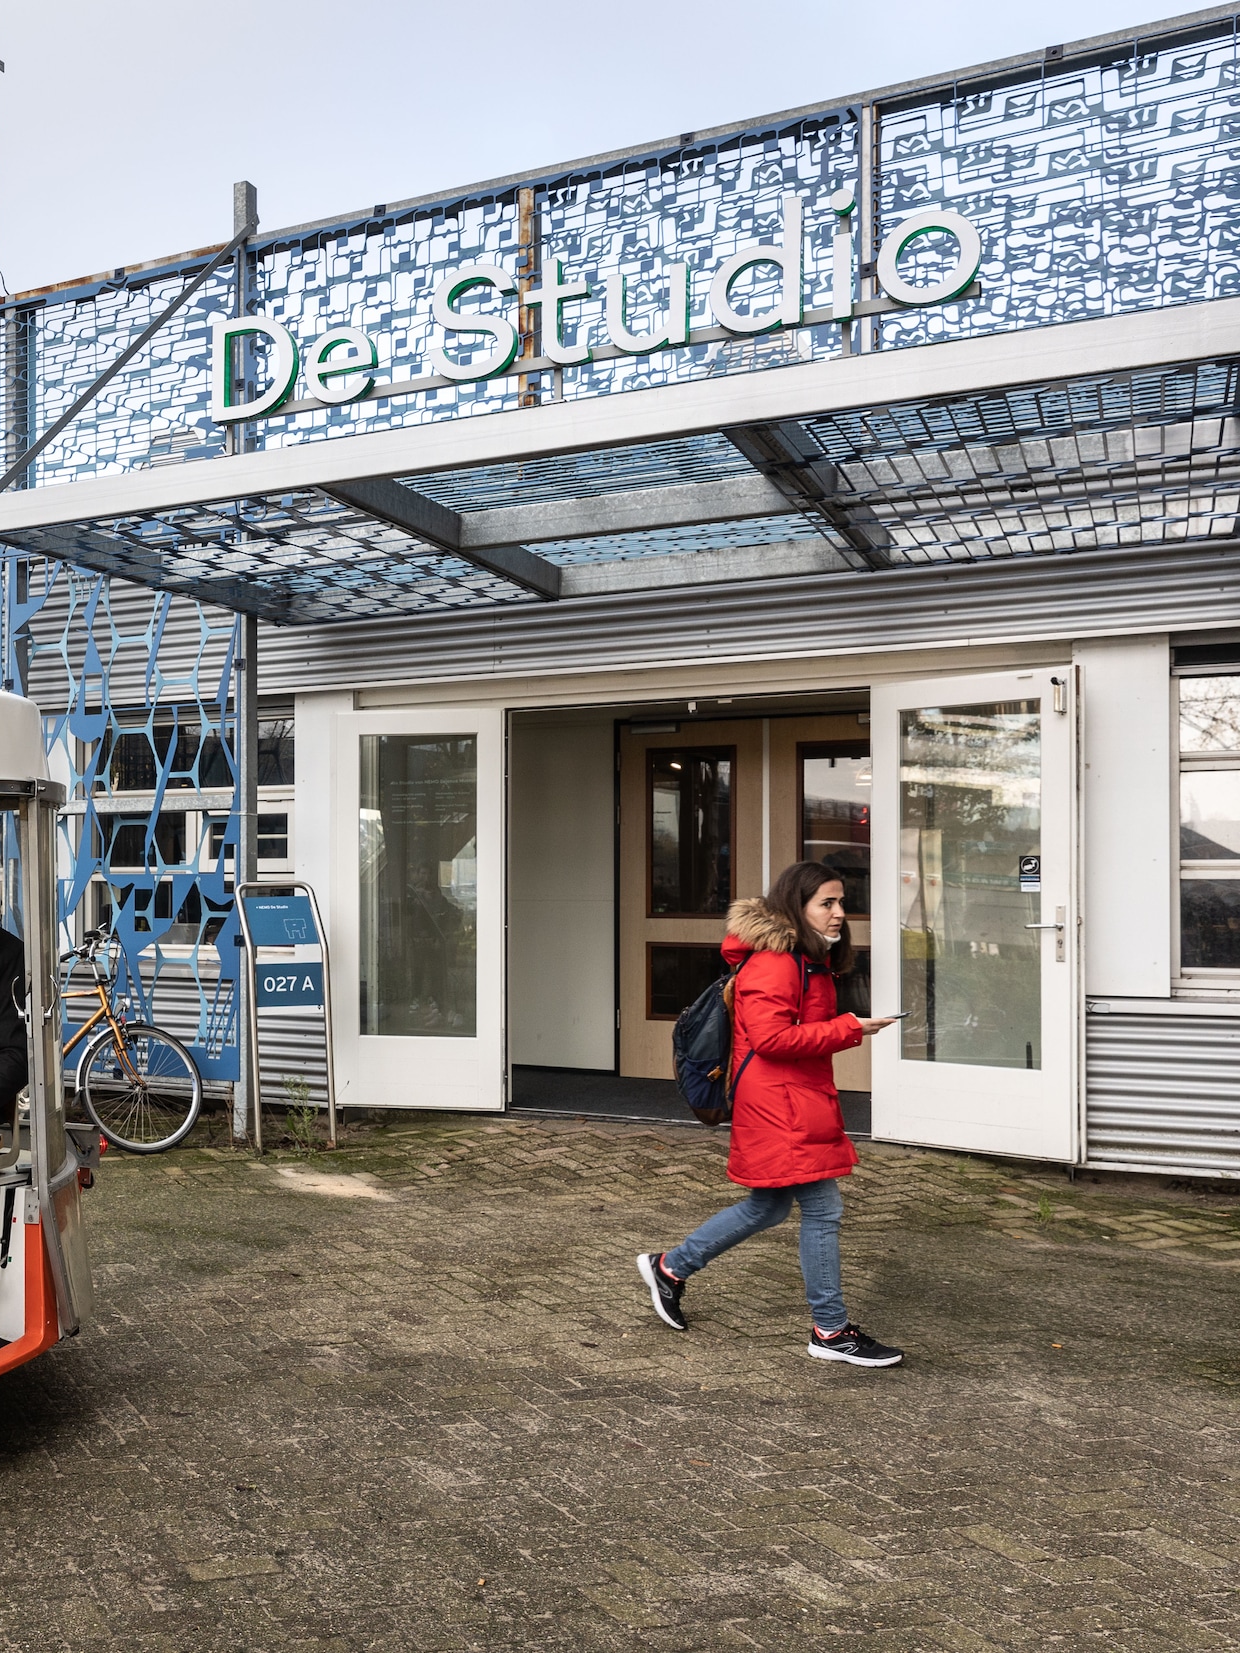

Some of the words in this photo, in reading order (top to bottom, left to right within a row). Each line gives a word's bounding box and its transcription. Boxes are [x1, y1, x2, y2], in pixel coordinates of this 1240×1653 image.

[212, 316, 379, 424] De
[427, 188, 982, 382] Studio
[263, 976, 298, 993] 027
[301, 975, 315, 991] A
